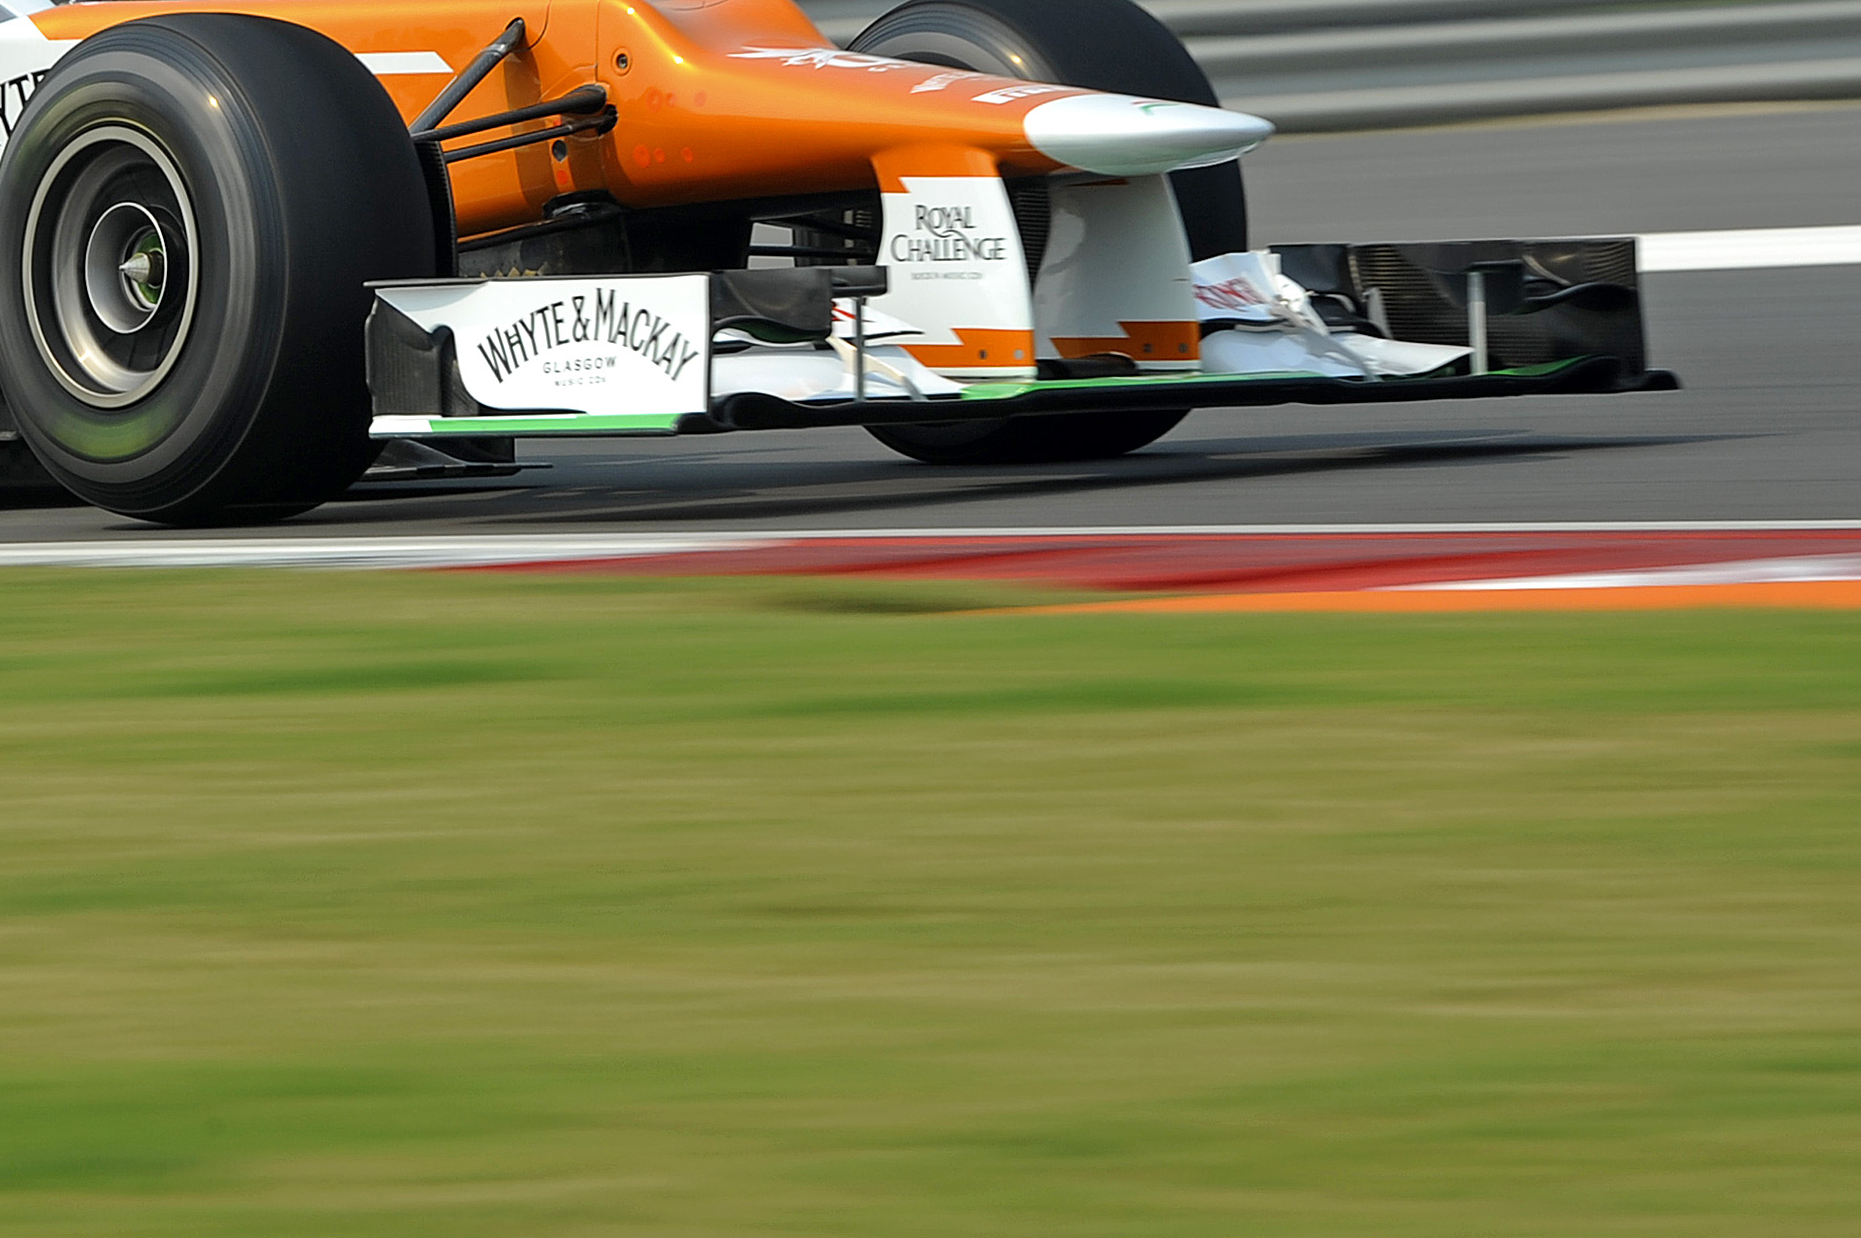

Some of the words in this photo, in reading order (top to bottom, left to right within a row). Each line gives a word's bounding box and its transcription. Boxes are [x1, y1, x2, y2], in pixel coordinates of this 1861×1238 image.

[915, 204, 977, 238] ROYAL
[890, 230, 1007, 262] CHALLENGE
[543, 356, 617, 374] GLASGOW
